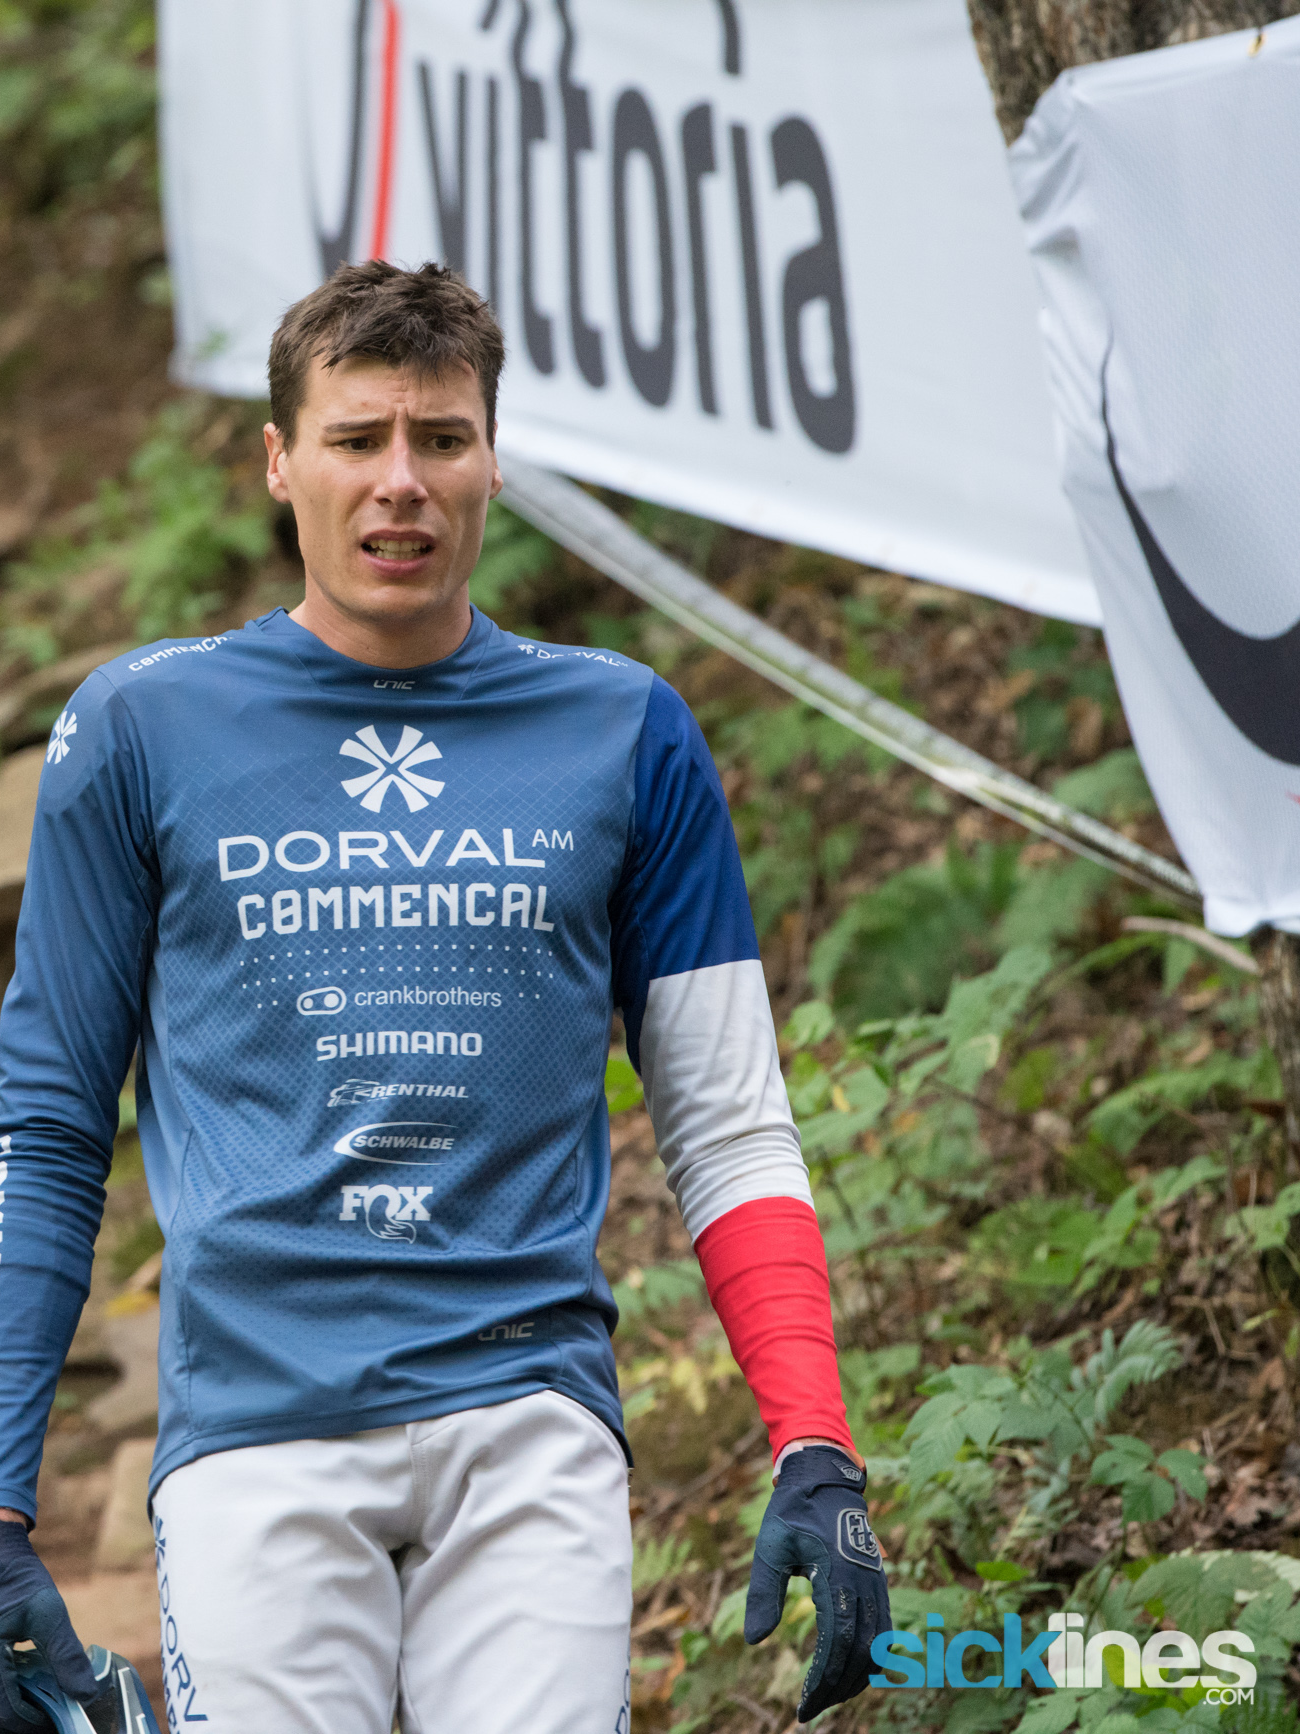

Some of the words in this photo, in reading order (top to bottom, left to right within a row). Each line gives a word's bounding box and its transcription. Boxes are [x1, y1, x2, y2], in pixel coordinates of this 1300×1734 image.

[218, 828, 546, 881] DORVAL
[532, 828, 574, 851] AM
[354, 986, 502, 1008] crankbrothers
[316, 1031, 482, 1061] SHIMANO
[369, 1083, 469, 1098] RENTHAL
[352, 1135, 455, 1150] SCHWALBE
[338, 1184, 433, 1222] FOX
